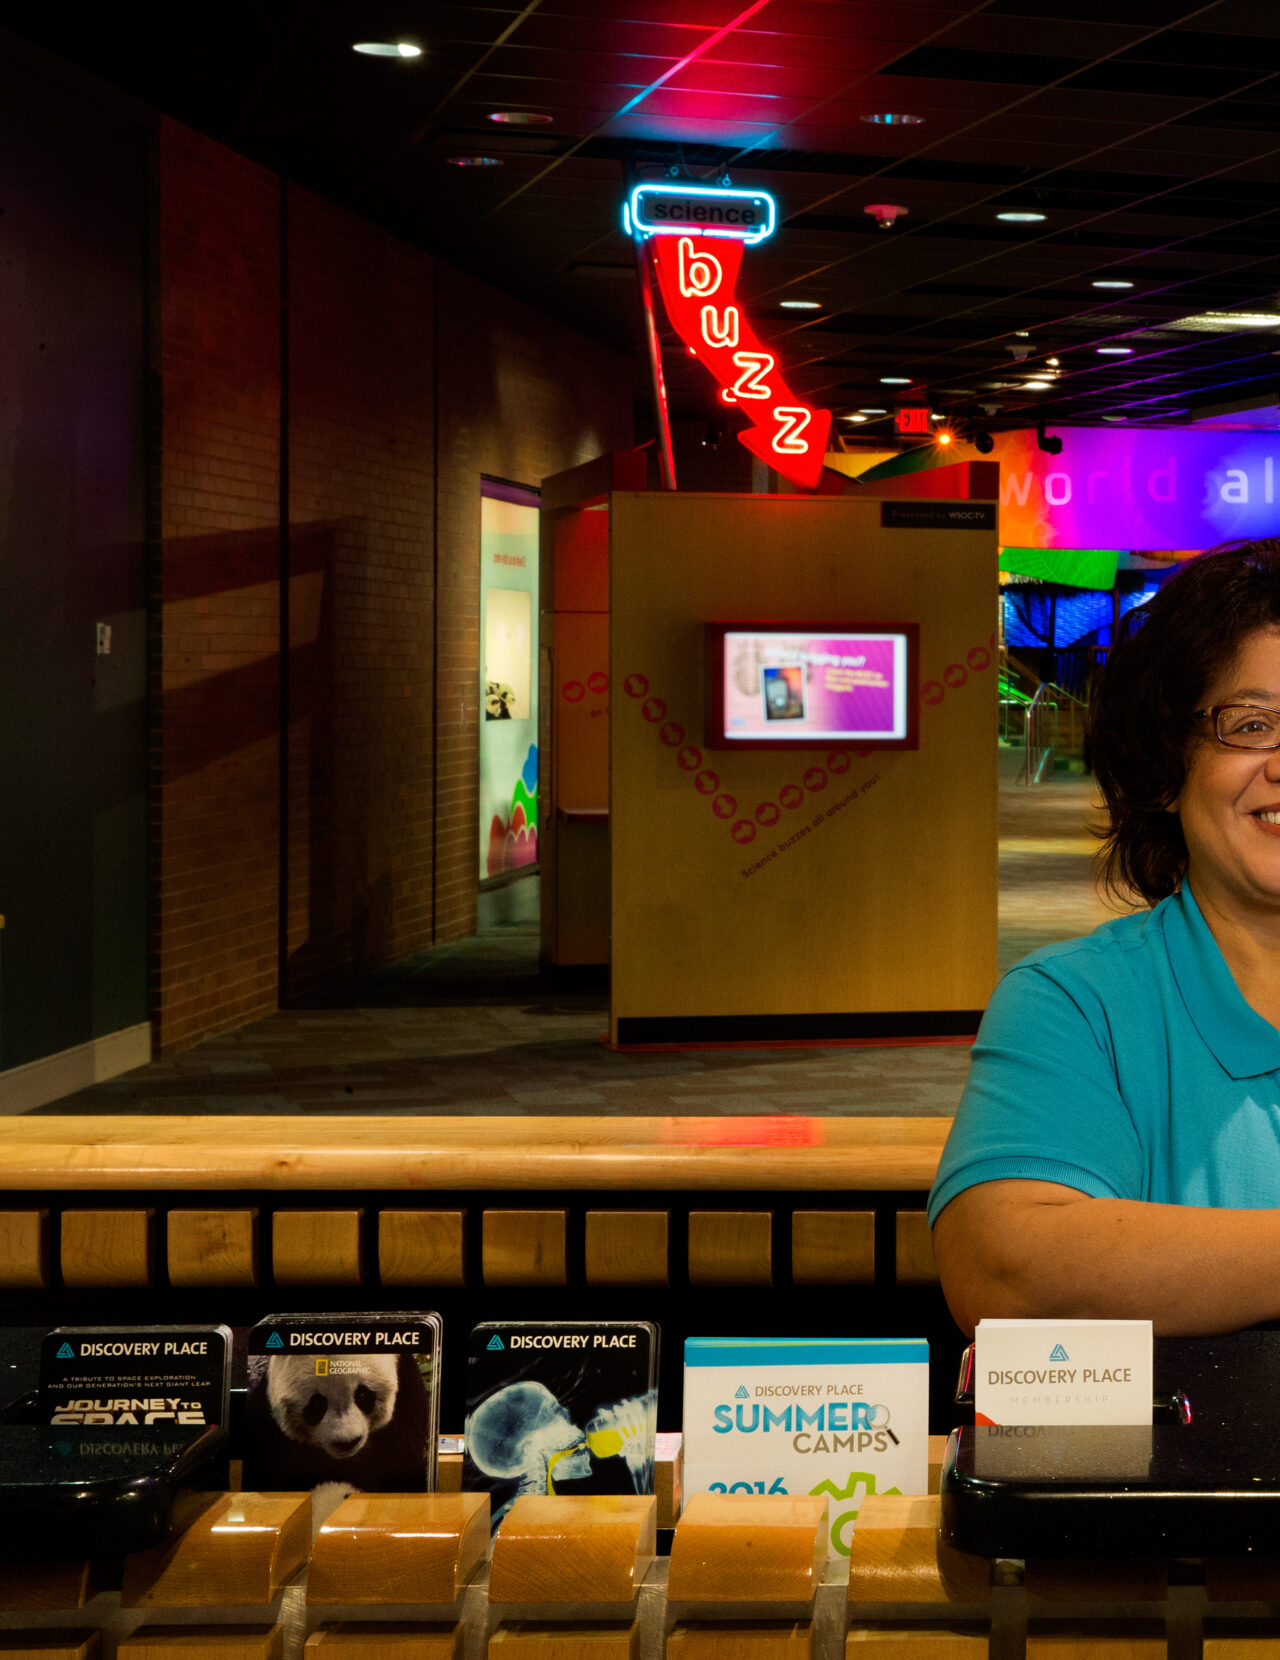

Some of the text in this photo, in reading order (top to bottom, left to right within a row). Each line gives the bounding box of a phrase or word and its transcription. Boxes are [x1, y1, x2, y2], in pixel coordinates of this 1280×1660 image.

[655, 201, 756, 225] science
[677, 236, 812, 455] buzz
[899, 408, 929, 432] EXIT
[999, 456, 1177, 506] world
[741, 850, 778, 879] Science
[777, 825, 812, 852] buzzes
[812, 813, 825, 828] all
[825, 789, 859, 818] around
[290, 1331, 420, 1347] DISCOVERY PLACE
[510, 1335, 637, 1349] DISCOVERY PLACE
[80, 1342, 208, 1357] DISCOVERY PLACE
[329, 1360, 362, 1368] NATIONAL
[329, 1367, 370, 1375] GEOGRAPHIC
[988, 1368, 1132, 1385] DISCOVERY PLACE
[754, 1384, 864, 1397] DISCOVERY PLACE
[54, 1398, 182, 1412] JOURNEY
[1009, 1394, 1109, 1405] MEMBERSHIP
[711, 1402, 877, 1434] SUMMER
[792, 1431, 888, 1454] CAMPS
